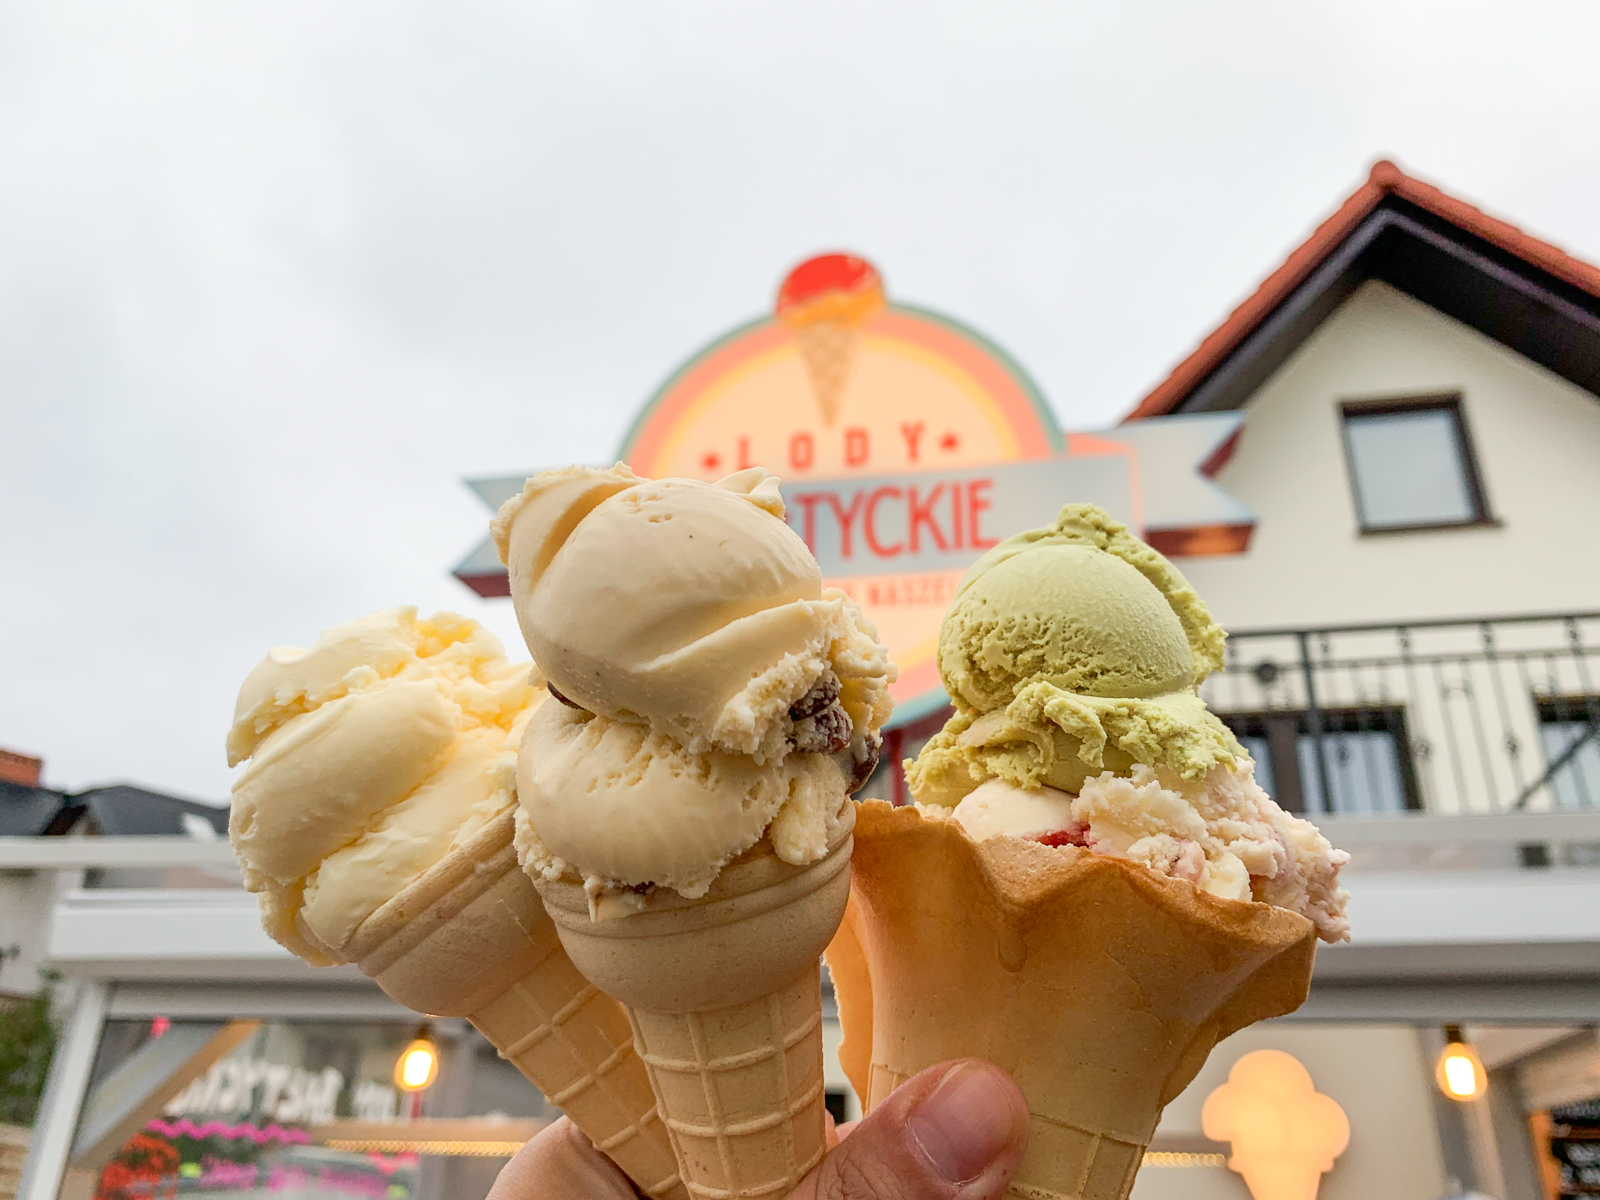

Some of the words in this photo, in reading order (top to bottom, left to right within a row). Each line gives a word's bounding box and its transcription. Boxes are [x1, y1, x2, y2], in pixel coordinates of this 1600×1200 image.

[737, 421, 926, 471] LODY
[785, 477, 1001, 560] TYCKIE
[866, 574, 957, 608] NASZE
